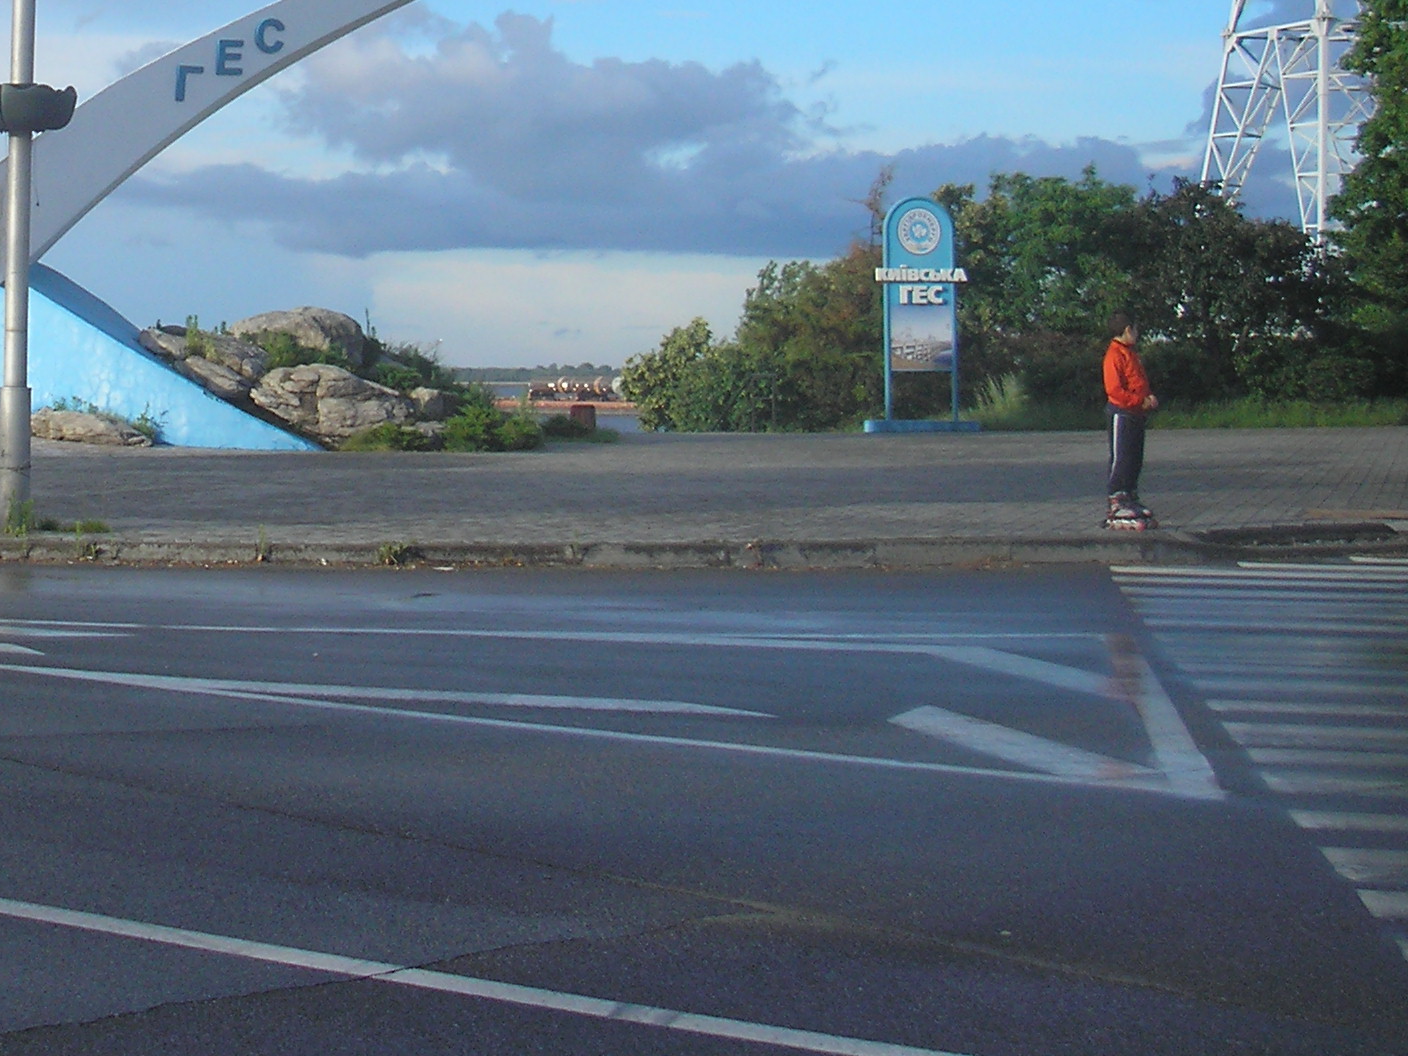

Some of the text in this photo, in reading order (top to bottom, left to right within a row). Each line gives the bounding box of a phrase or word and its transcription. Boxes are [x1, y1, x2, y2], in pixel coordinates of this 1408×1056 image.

[175, 18, 285, 102] ГЕС
[875, 264, 968, 282] КИЇВСЬКА
[899, 285, 943, 304] ГЕС
